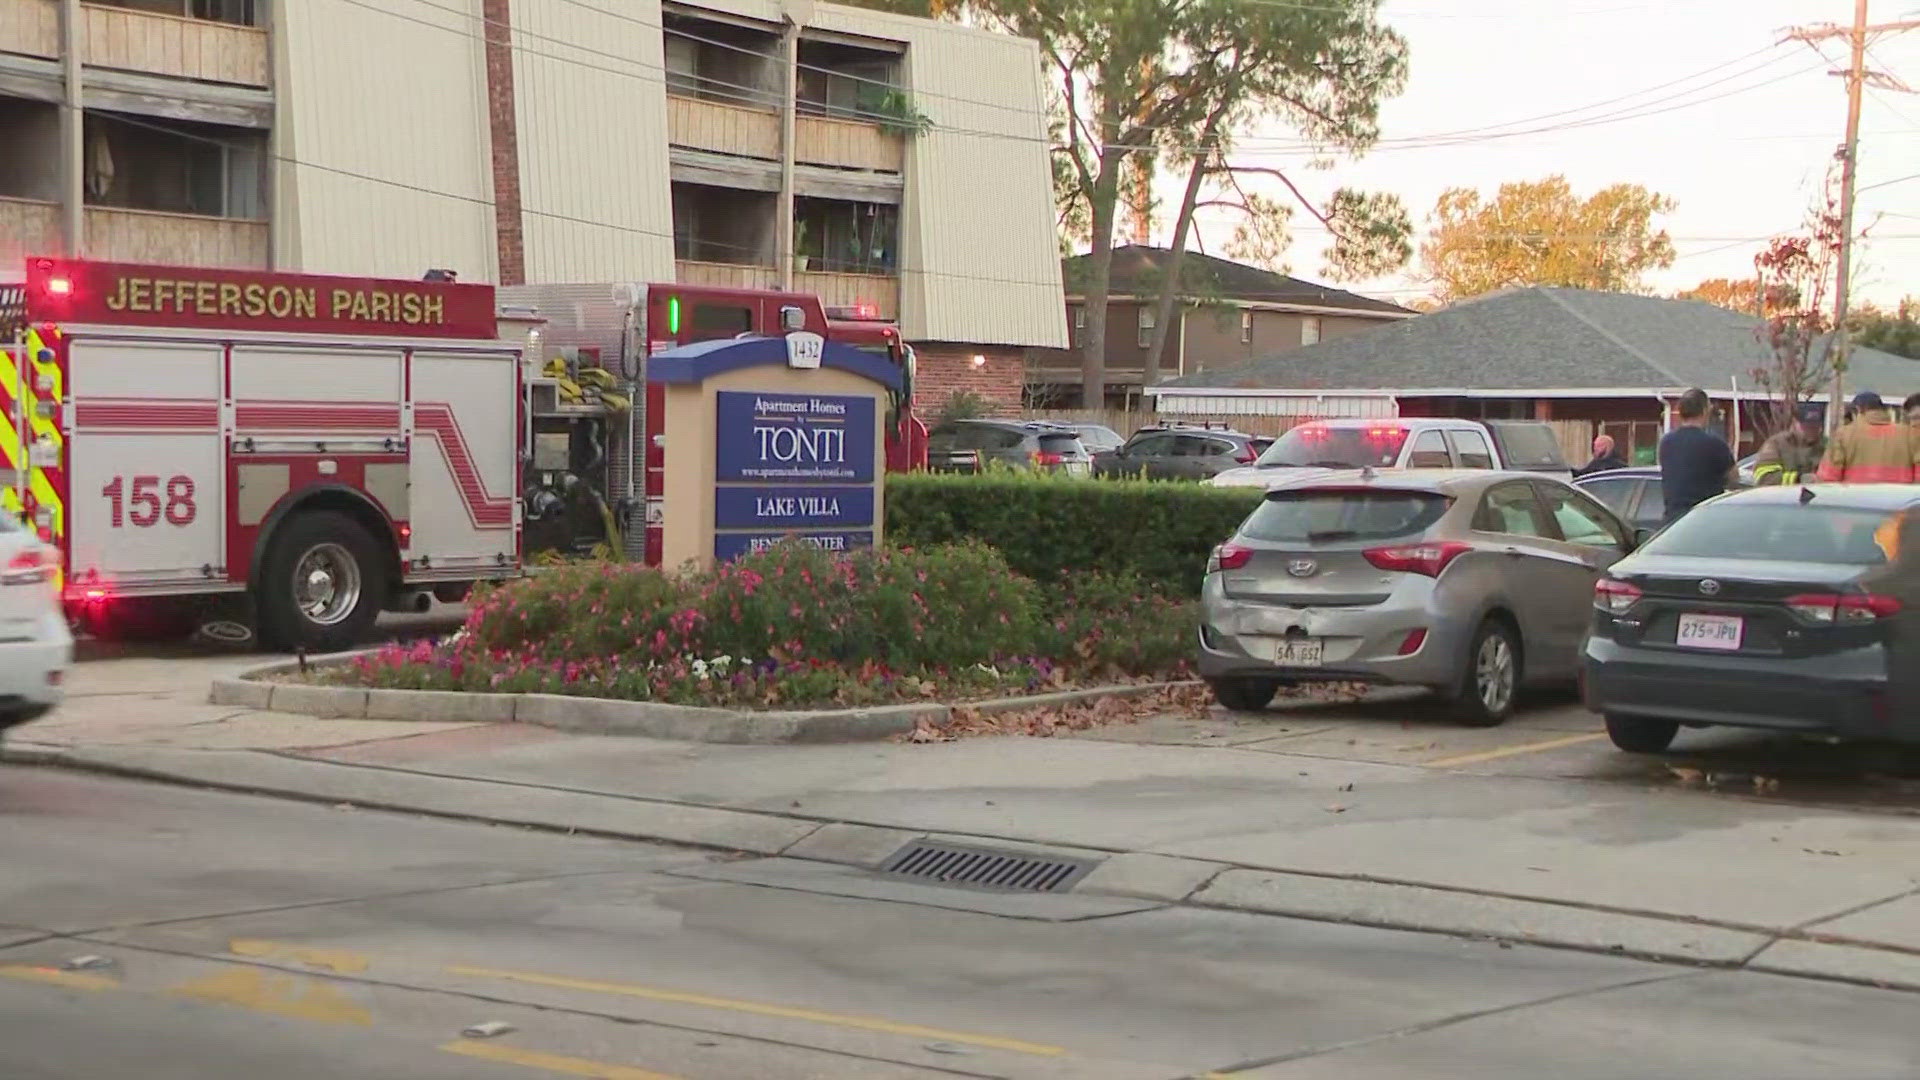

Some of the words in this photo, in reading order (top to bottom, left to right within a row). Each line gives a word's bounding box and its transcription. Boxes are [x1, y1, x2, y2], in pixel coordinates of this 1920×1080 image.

[107, 277, 316, 318] JEFFERSON
[332, 289, 444, 325] PARISH
[794, 341, 819, 358] 1432
[754, 396, 807, 416] Apartment
[810, 399, 846, 415] Homes
[753, 427, 845, 462] TONTI
[102, 474, 197, 528] 158
[757, 497, 795, 516] LAKE
[799, 497, 840, 516] VILLA
[800, 536, 845, 550] ENTER
[1682, 622, 1705, 638] 275
